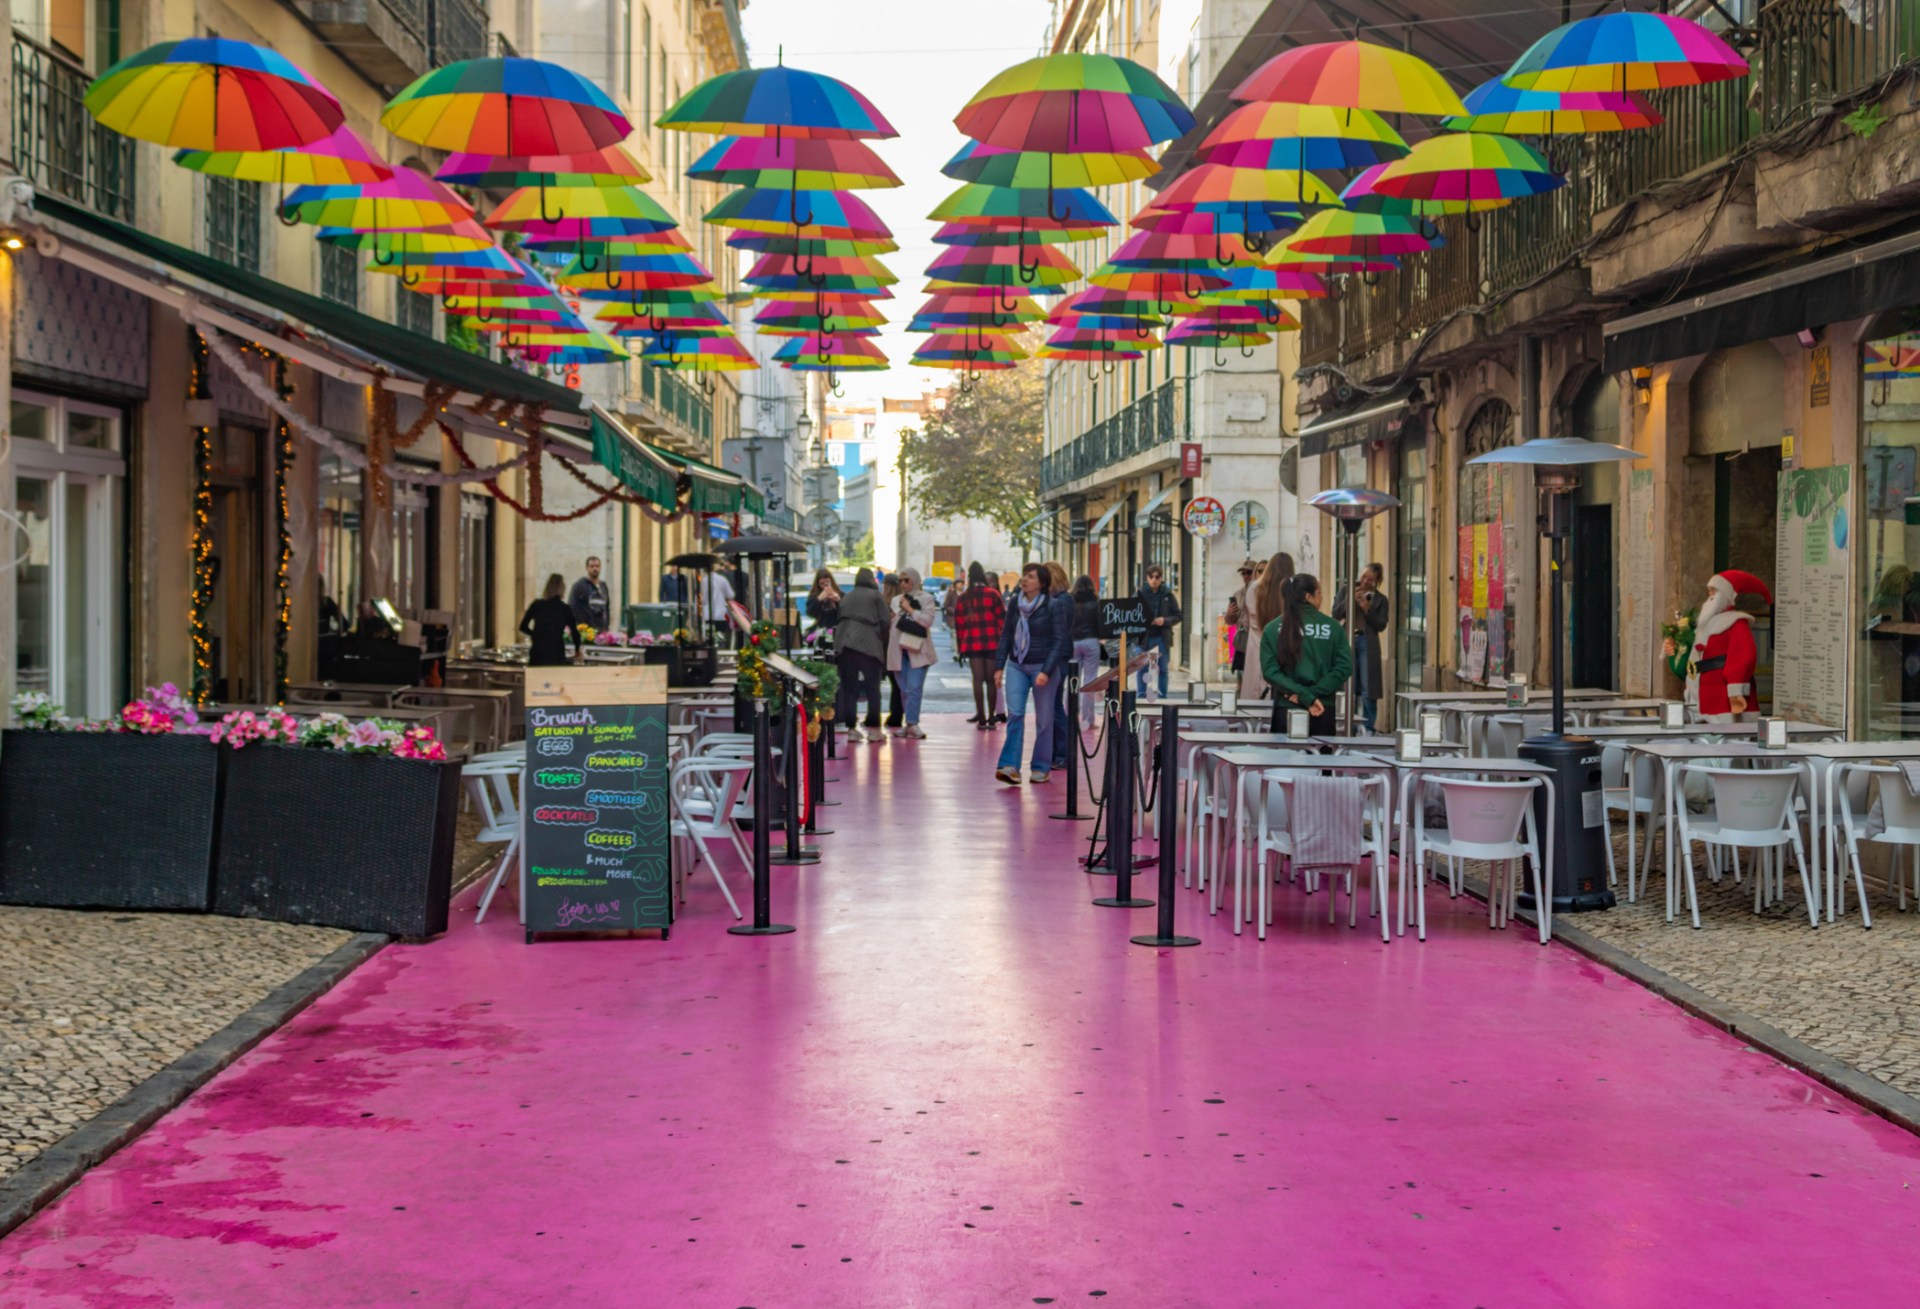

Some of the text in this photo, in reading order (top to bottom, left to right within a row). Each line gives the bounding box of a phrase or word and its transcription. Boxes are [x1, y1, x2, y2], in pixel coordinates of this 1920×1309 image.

[530, 708, 596, 726] Brunch
[534, 726, 584, 737] SATURDAY
[594, 725, 634, 735] SUNDAY
[542, 741, 571, 752] EGGS
[588, 756, 643, 767] PANCAKES
[538, 772, 581, 784] TOASTS
[588, 793, 643, 805] SMOOTHIES
[535, 809, 596, 821] COCKTAILS
[588, 832, 632, 846] COFFEES
[594, 856, 623, 866] MUCH
